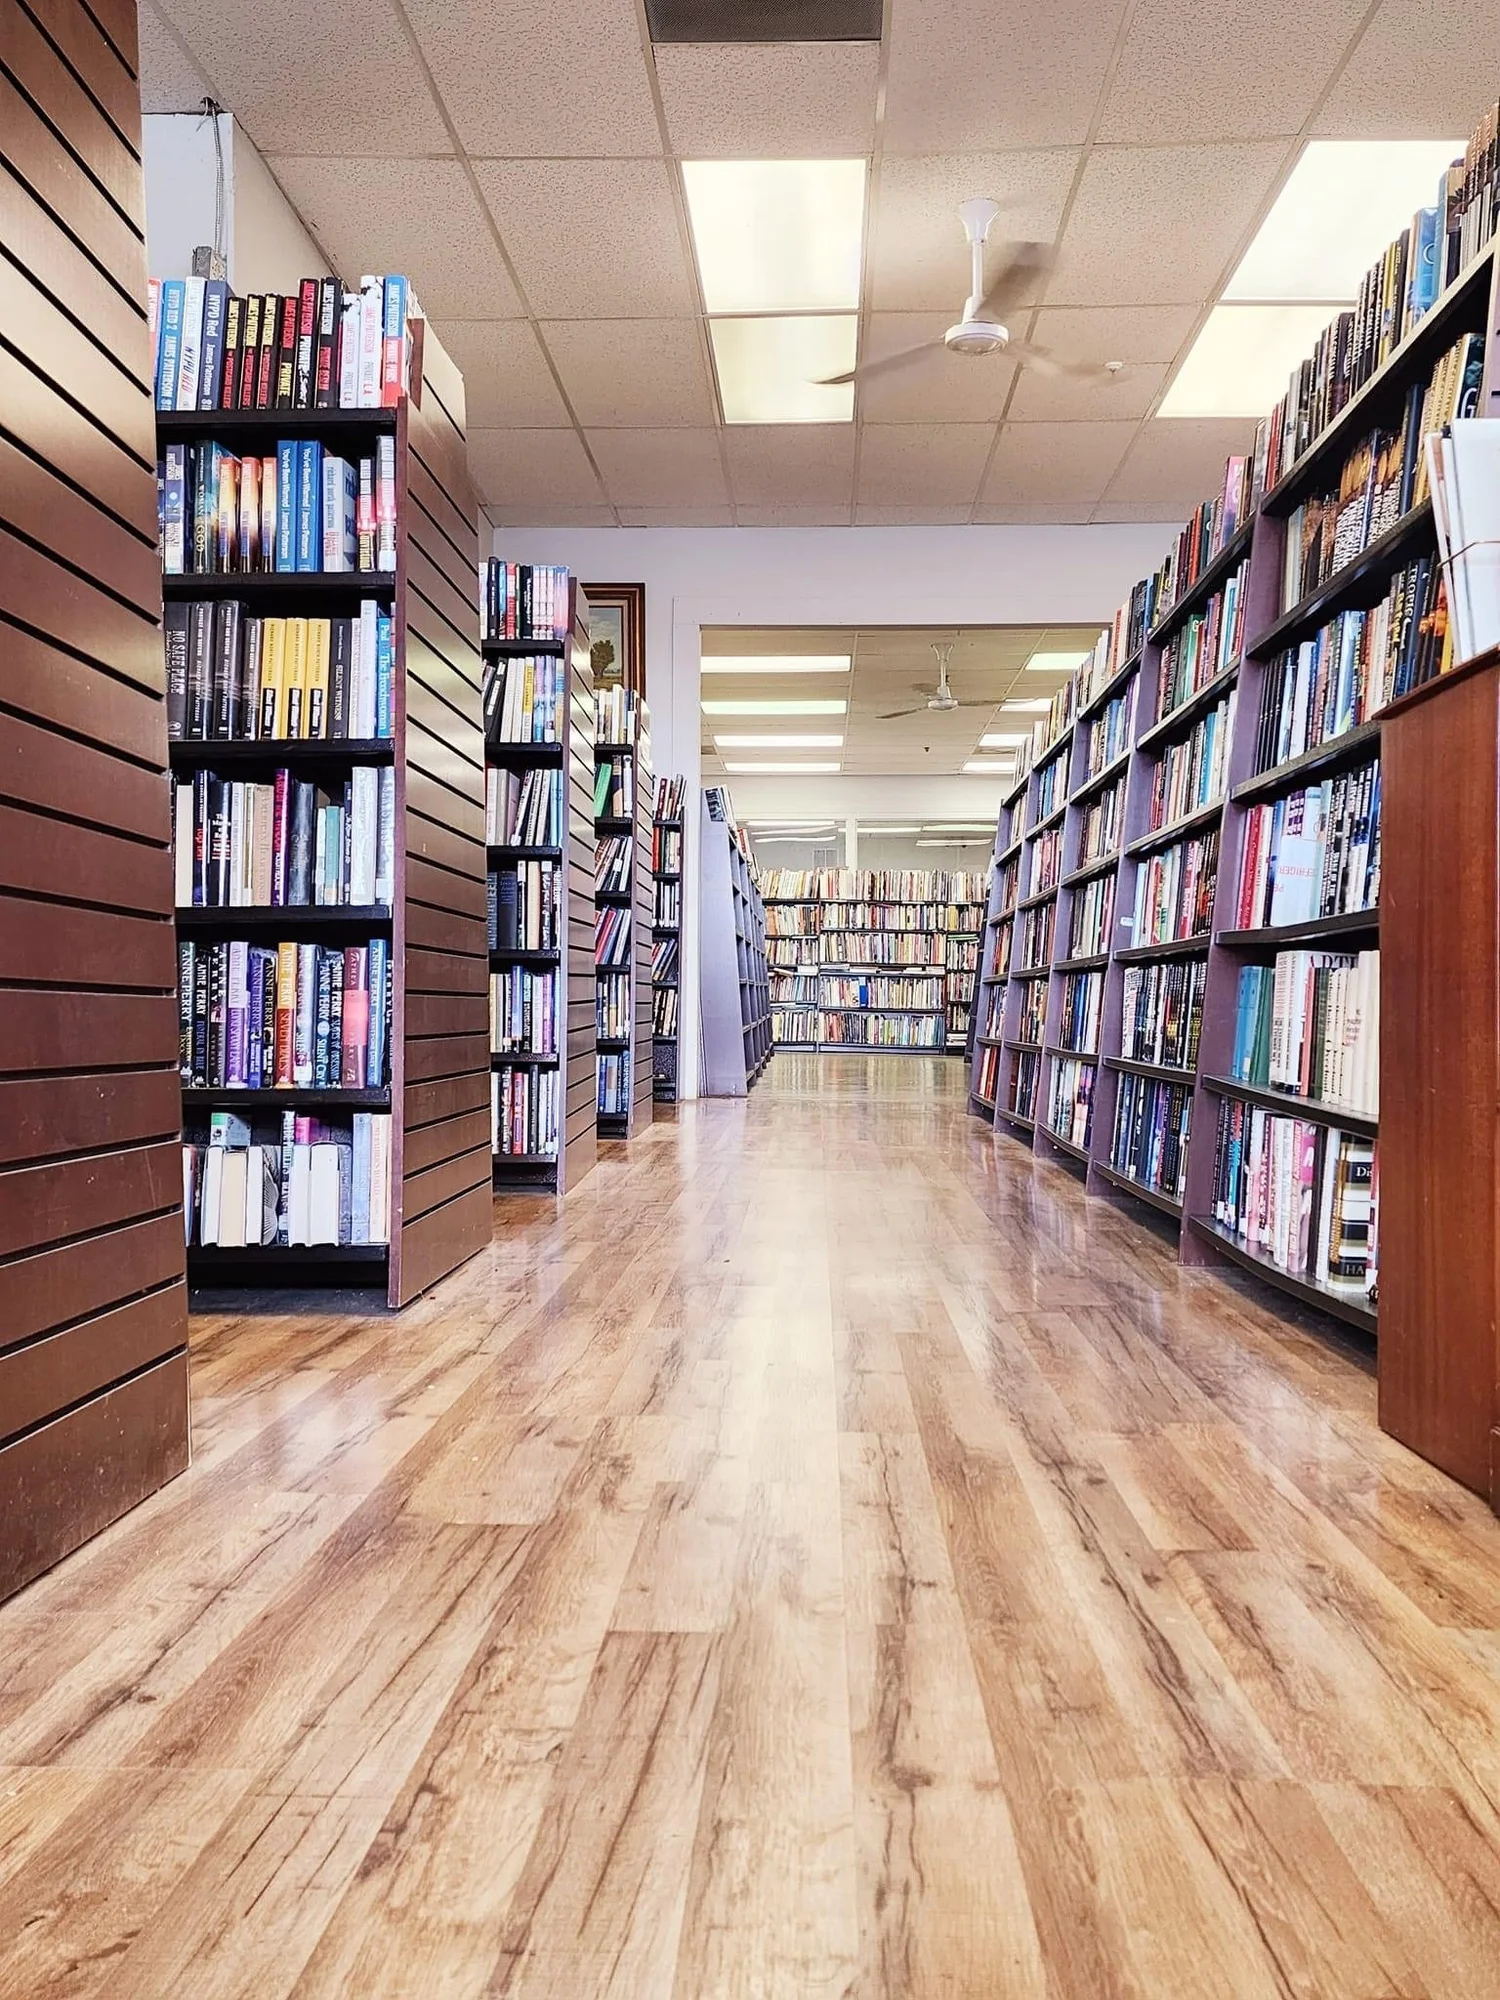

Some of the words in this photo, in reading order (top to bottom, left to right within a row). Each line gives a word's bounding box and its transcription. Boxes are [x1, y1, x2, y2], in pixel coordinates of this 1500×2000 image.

[208, 295, 220, 317] NYPD
[206, 320, 218, 336] Red
[165, 335, 177, 357] JAMES
[206, 344, 216, 363] James
[298, 336, 311, 369] PRIVATE
[162, 358, 176, 396] PATTERSON
[203, 365, 214, 395] Patterson
[225, 357, 233, 385] POSTCARD
[244, 355, 253, 382] POSTCARD
[280, 363, 292, 396] PRIVATE
[223, 387, 232, 408] KILLERS
[243, 384, 252, 405] KILLERS
[260, 383, 268, 404] KILLERS
[283, 448, 291, 467] You've
[303, 448, 311, 467] You've
[282, 468, 290, 482] Been
[302, 468, 310, 482] Been
[282, 484, 290, 506] Warned
[302, 484, 310, 506] Warned
[196, 525, 204, 551] GOD
[281, 530, 289, 558] Patterson
[301, 530, 309, 558] Patterson
[1404, 565, 1418, 617] TROPIC
[173, 631, 185, 642] NO
[381, 625, 390, 641] Paul
[171, 645, 185, 666] SAFE
[380, 653, 390, 671] The
[171, 669, 185, 695] PLACE
[335, 665, 343, 689] SILENT
[334, 690, 343, 721] WITNESS
[380, 673, 391, 730] Frenchwoman
[195, 828, 203, 843] Top
[181, 949, 192, 983] ANNE
[196, 964, 207, 985] ANNE
[219, 952, 227, 997] ANNE
[253, 965, 261, 992] ANNE
[266, 964, 274, 992] ANNE
[320, 966, 329, 992] ANNE
[332, 965, 341, 987] ANNE
[350, 952, 359, 985] TATHEA
[181, 985, 192, 1022] PERRY
[196, 990, 206, 1015] PERRY
[281, 978, 292, 1005] PERRY
[332, 991, 341, 1017] PERRY
[252, 994, 261, 1026] PERRY
[264, 994, 273, 1026] PERRY
[319, 994, 329, 1020] PERRY
[196, 1021, 205, 1045] FUNERAL
[281, 1013, 291, 1042] SEVEN
[196, 1056, 204, 1070] BLUE
[280, 1045, 290, 1071] DIALS
[317, 1039, 326, 1063] SILENT
[316, 1064, 326, 1080] CRY
